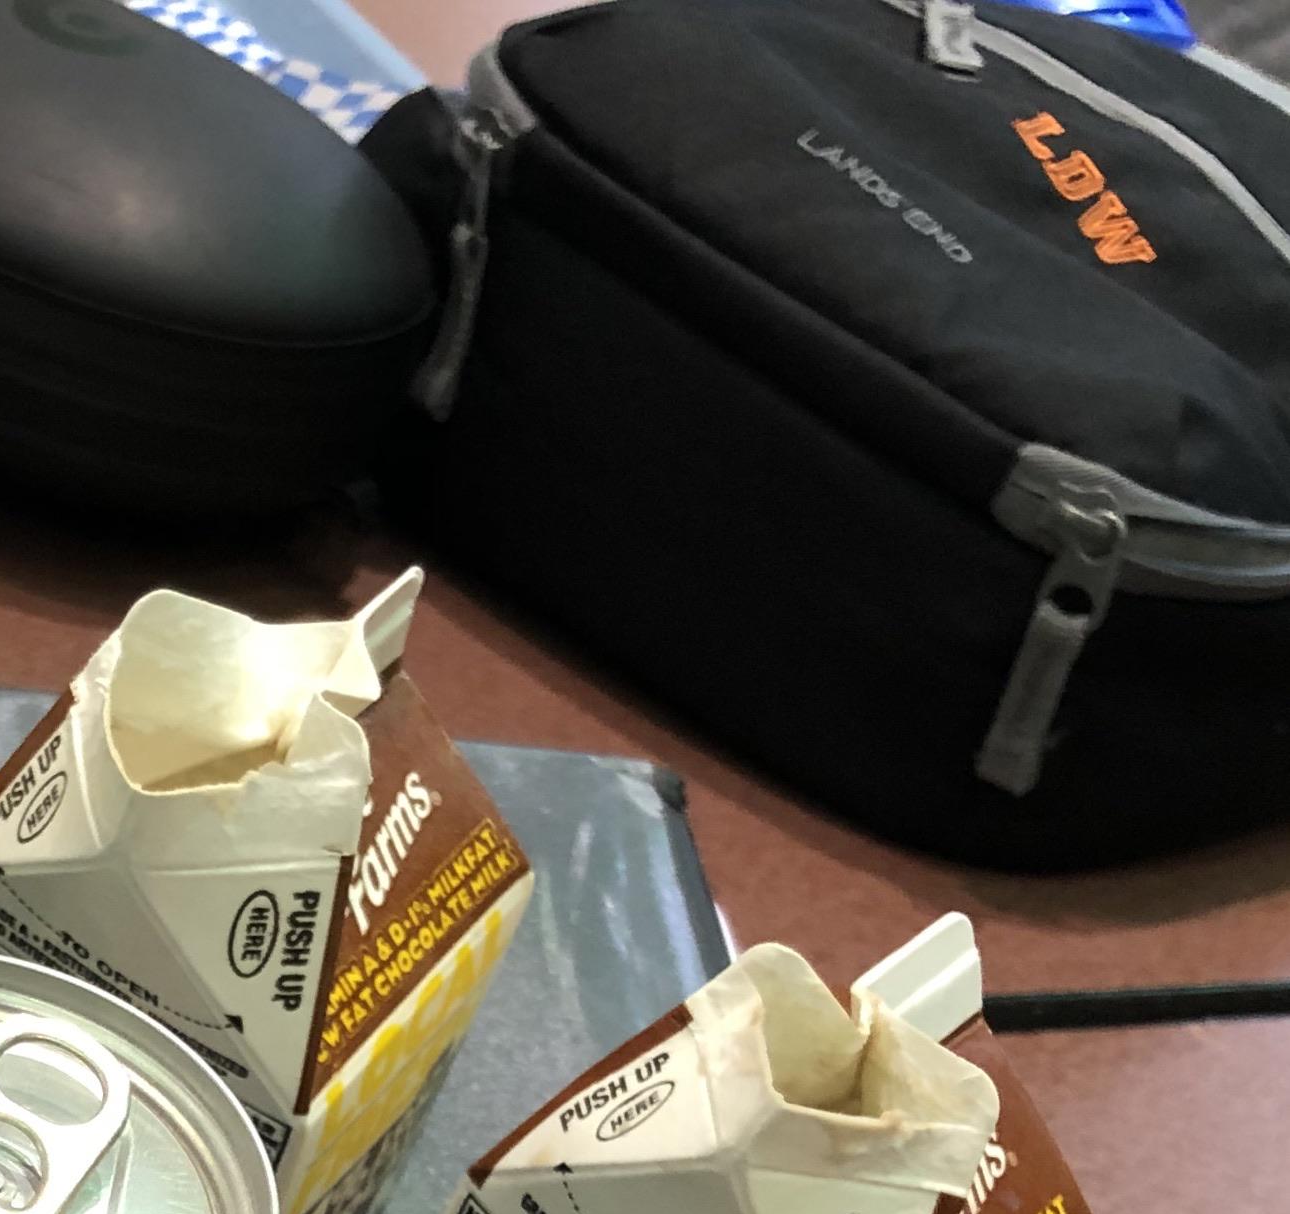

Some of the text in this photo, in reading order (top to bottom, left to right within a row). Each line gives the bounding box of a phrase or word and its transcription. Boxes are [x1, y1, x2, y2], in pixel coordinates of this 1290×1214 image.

[1013, 111, 1158, 264] LDW
[38, 735, 61, 774] UP
[26, 784, 59, 833] HERE
[241, 907, 269, 962] HERE
[363, 827, 500, 977] A & D MILKFAT
[59, 930, 159, 1007] TO OPEN
[271, 891, 320, 1012] PUSH UP
[339, 852, 512, 1037] FAT CHOCOLATE MILK
[559, 1052, 670, 1133] PUSH UP
[610, 1090, 662, 1132] HERE
